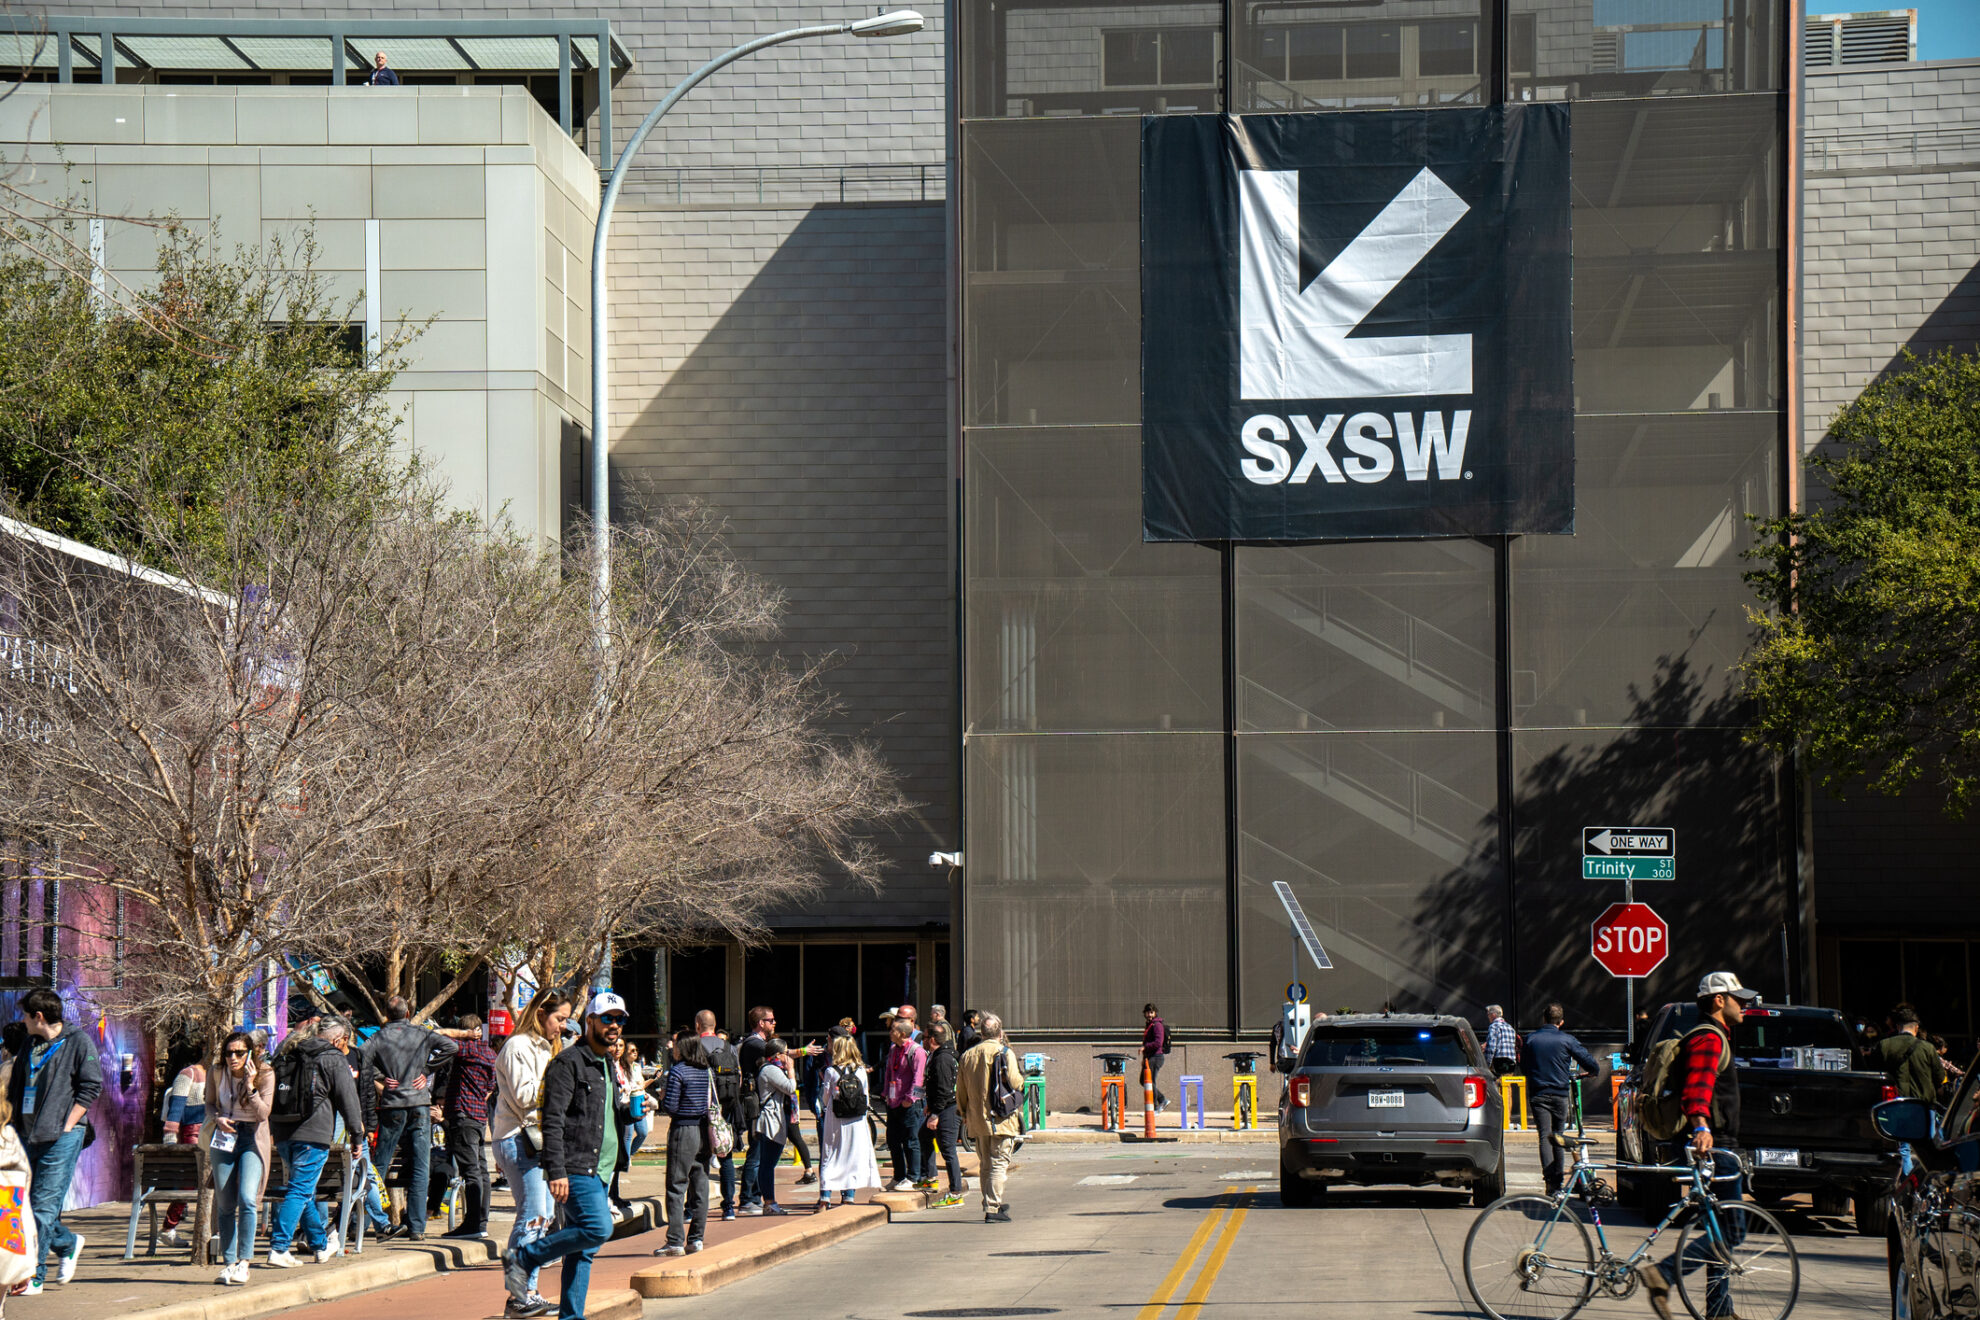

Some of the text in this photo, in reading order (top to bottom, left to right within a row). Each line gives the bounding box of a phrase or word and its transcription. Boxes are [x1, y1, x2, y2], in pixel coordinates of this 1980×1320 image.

[1610, 836, 1664, 848] ONE WAY
[1586, 859, 1672, 879] Trinity ST
[1652, 869, 1672, 878] 300
[1597, 926, 1663, 954] STOP
